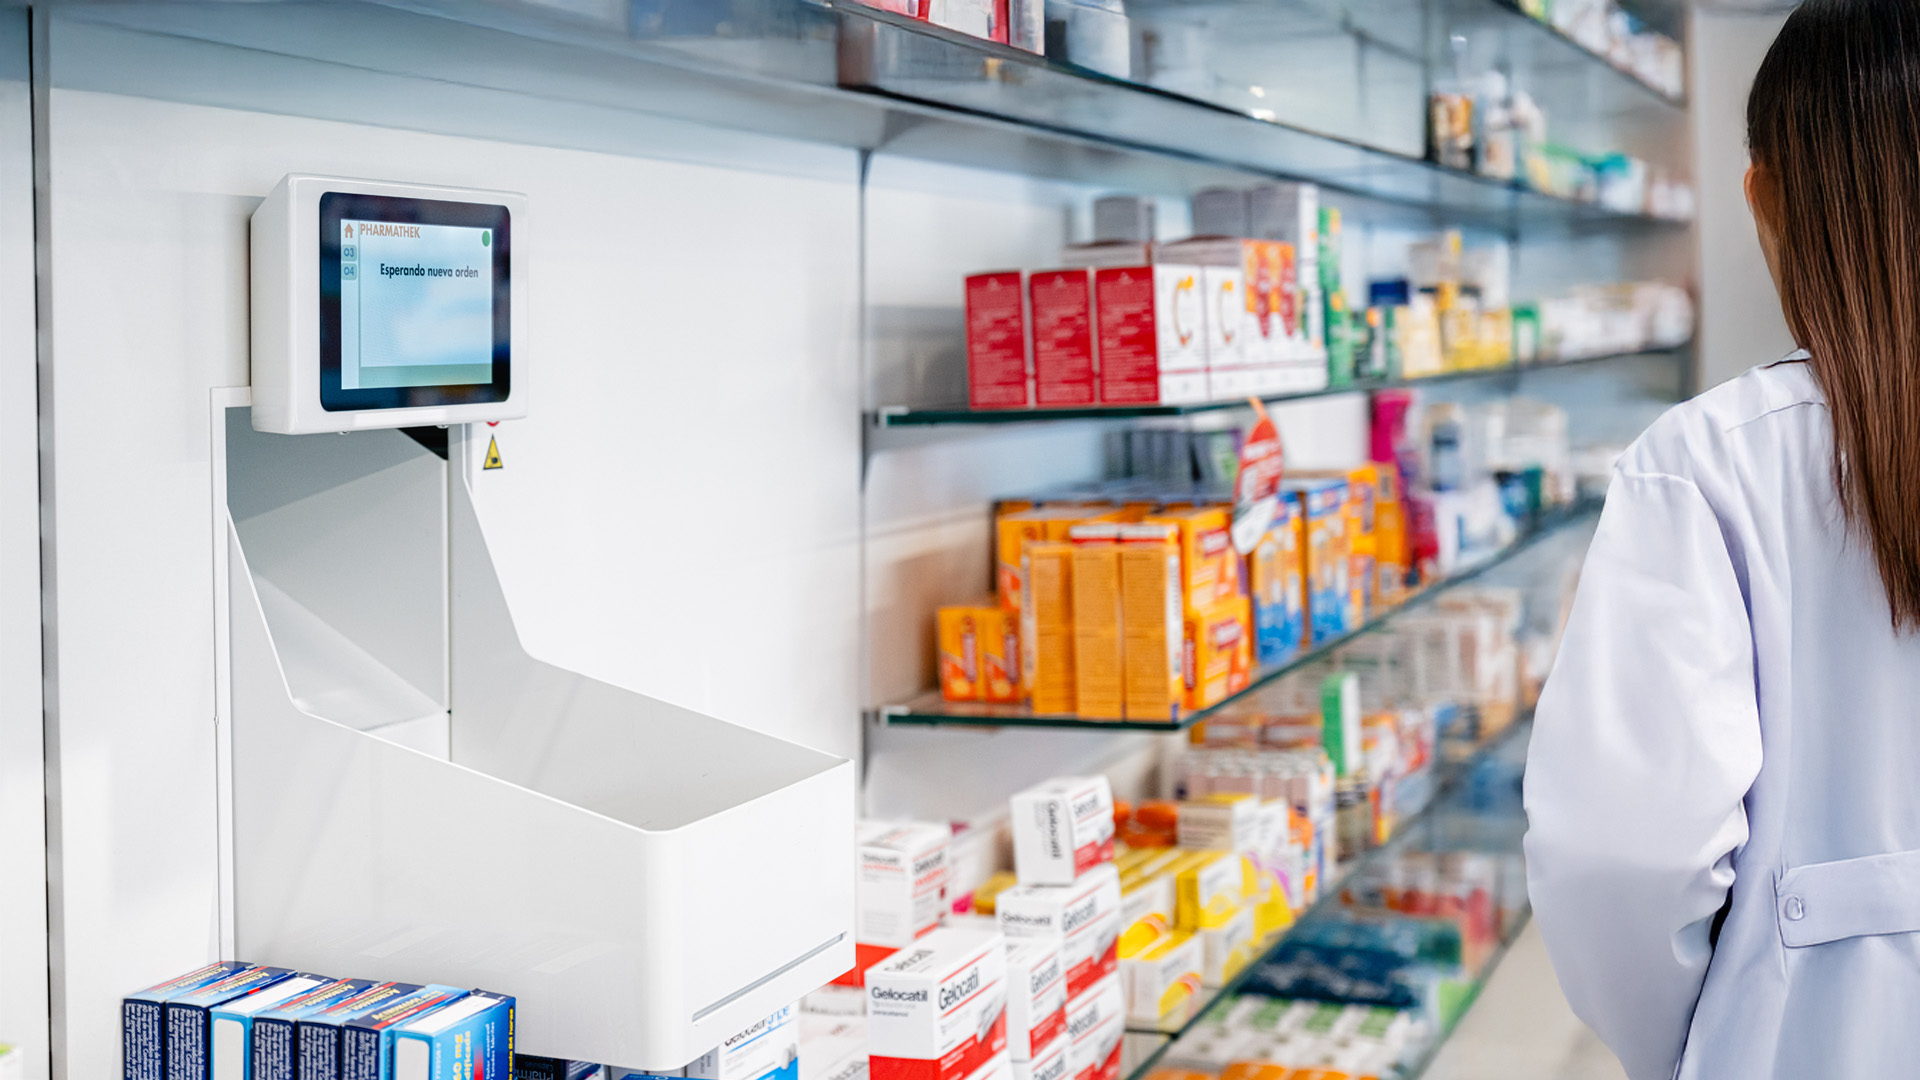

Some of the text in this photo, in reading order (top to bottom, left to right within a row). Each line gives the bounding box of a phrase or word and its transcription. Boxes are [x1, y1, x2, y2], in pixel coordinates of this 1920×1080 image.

[360, 223, 420, 238] PHARMATHEK
[343, 247, 355, 257] 03
[343, 266, 355, 276] 04
[380, 263, 479, 279] Esperando nueva orden
[871, 986, 928, 1002] Gelocatil
[938, 966, 980, 1011] Gelocatil
[455, 1033, 464, 1059] mg
[509, 1036, 514, 1049] 24
